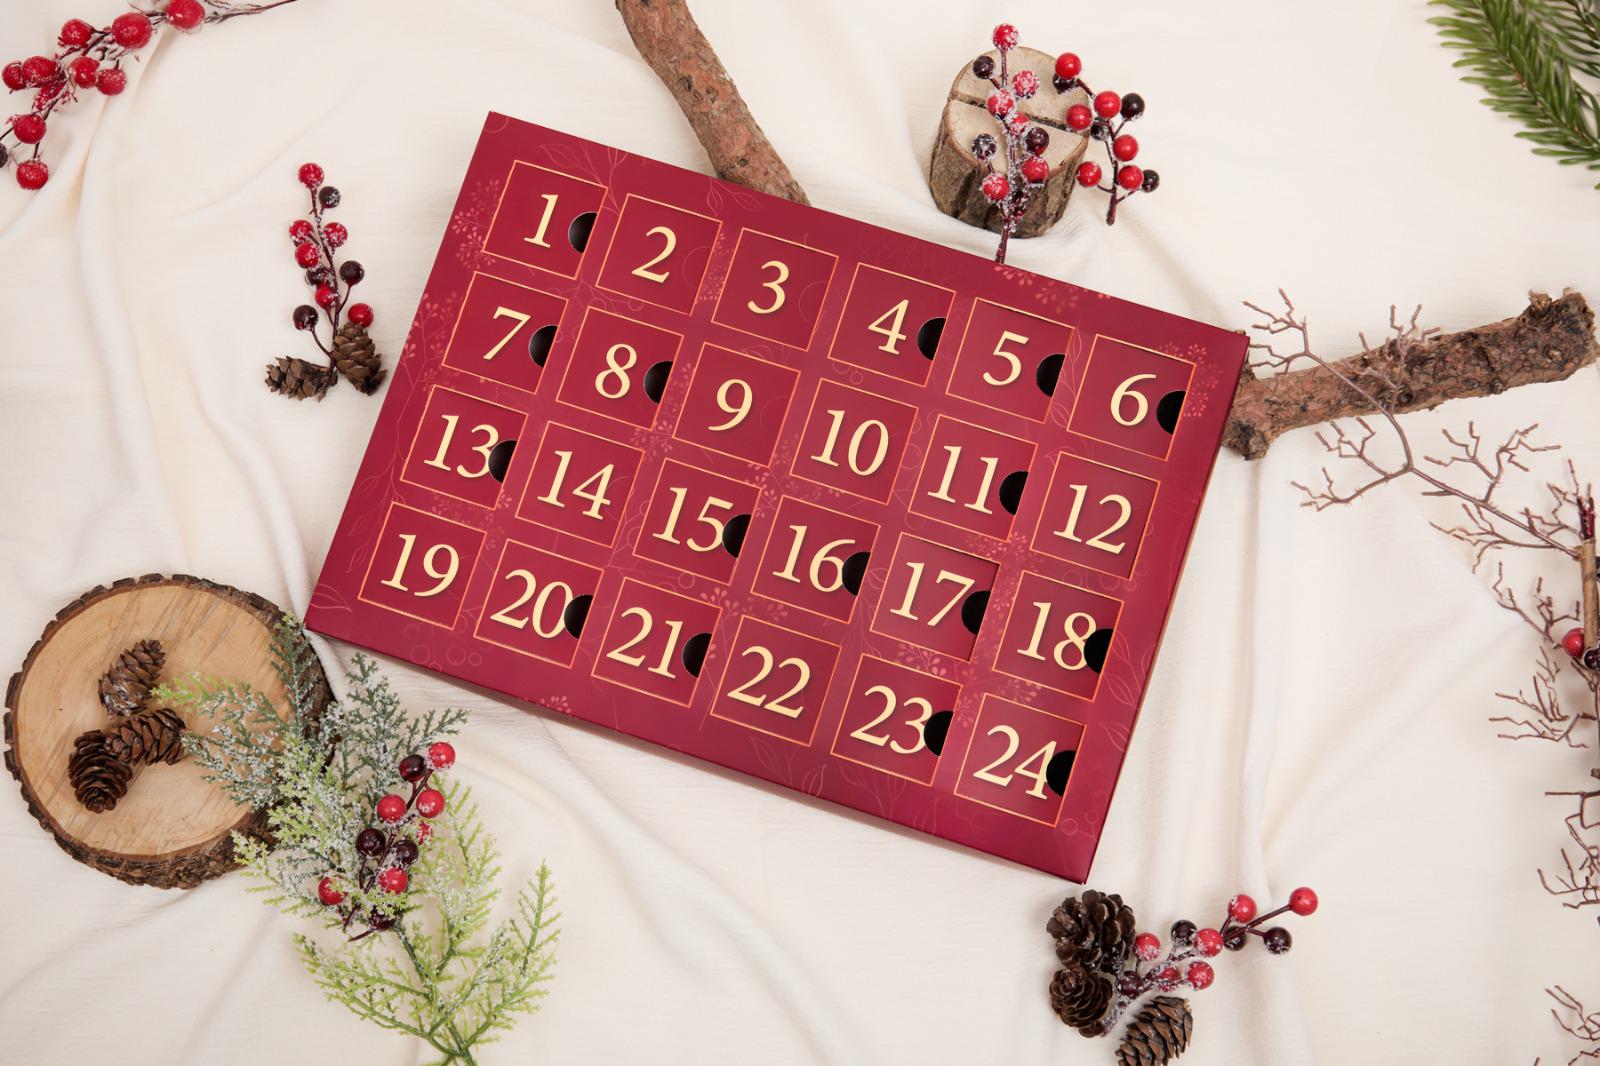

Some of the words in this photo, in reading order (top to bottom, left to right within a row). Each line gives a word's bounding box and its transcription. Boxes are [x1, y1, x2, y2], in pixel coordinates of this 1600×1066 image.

[524, 194, 559, 248] 1
[631, 226, 677, 283] 2
[747, 260, 789, 314] 3
[483, 306, 531, 360] 7
[868, 299, 909, 355] 4
[982, 330, 1029, 386] 5
[595, 343, 637, 399] 8
[1110, 373, 1156, 426] 6
[708, 379, 753, 431] 9
[424, 414, 499, 478] 13
[811, 409, 889, 476] 10
[537, 450, 614, 520] 14
[927, 445, 999, 515] 11
[653, 487, 733, 552] 15
[1053, 484, 1132, 554] 12
[381, 534, 459, 597] 19
[772, 525, 856, 592] 16
[490, 569, 574, 639] 20
[890, 561, 976, 626] 17
[606, 607, 683, 679] 21
[1017, 601, 1097, 670] 18
[727, 645, 811, 719] 22
[850, 685, 933, 754] 23
[973, 724, 1057, 800] 24
